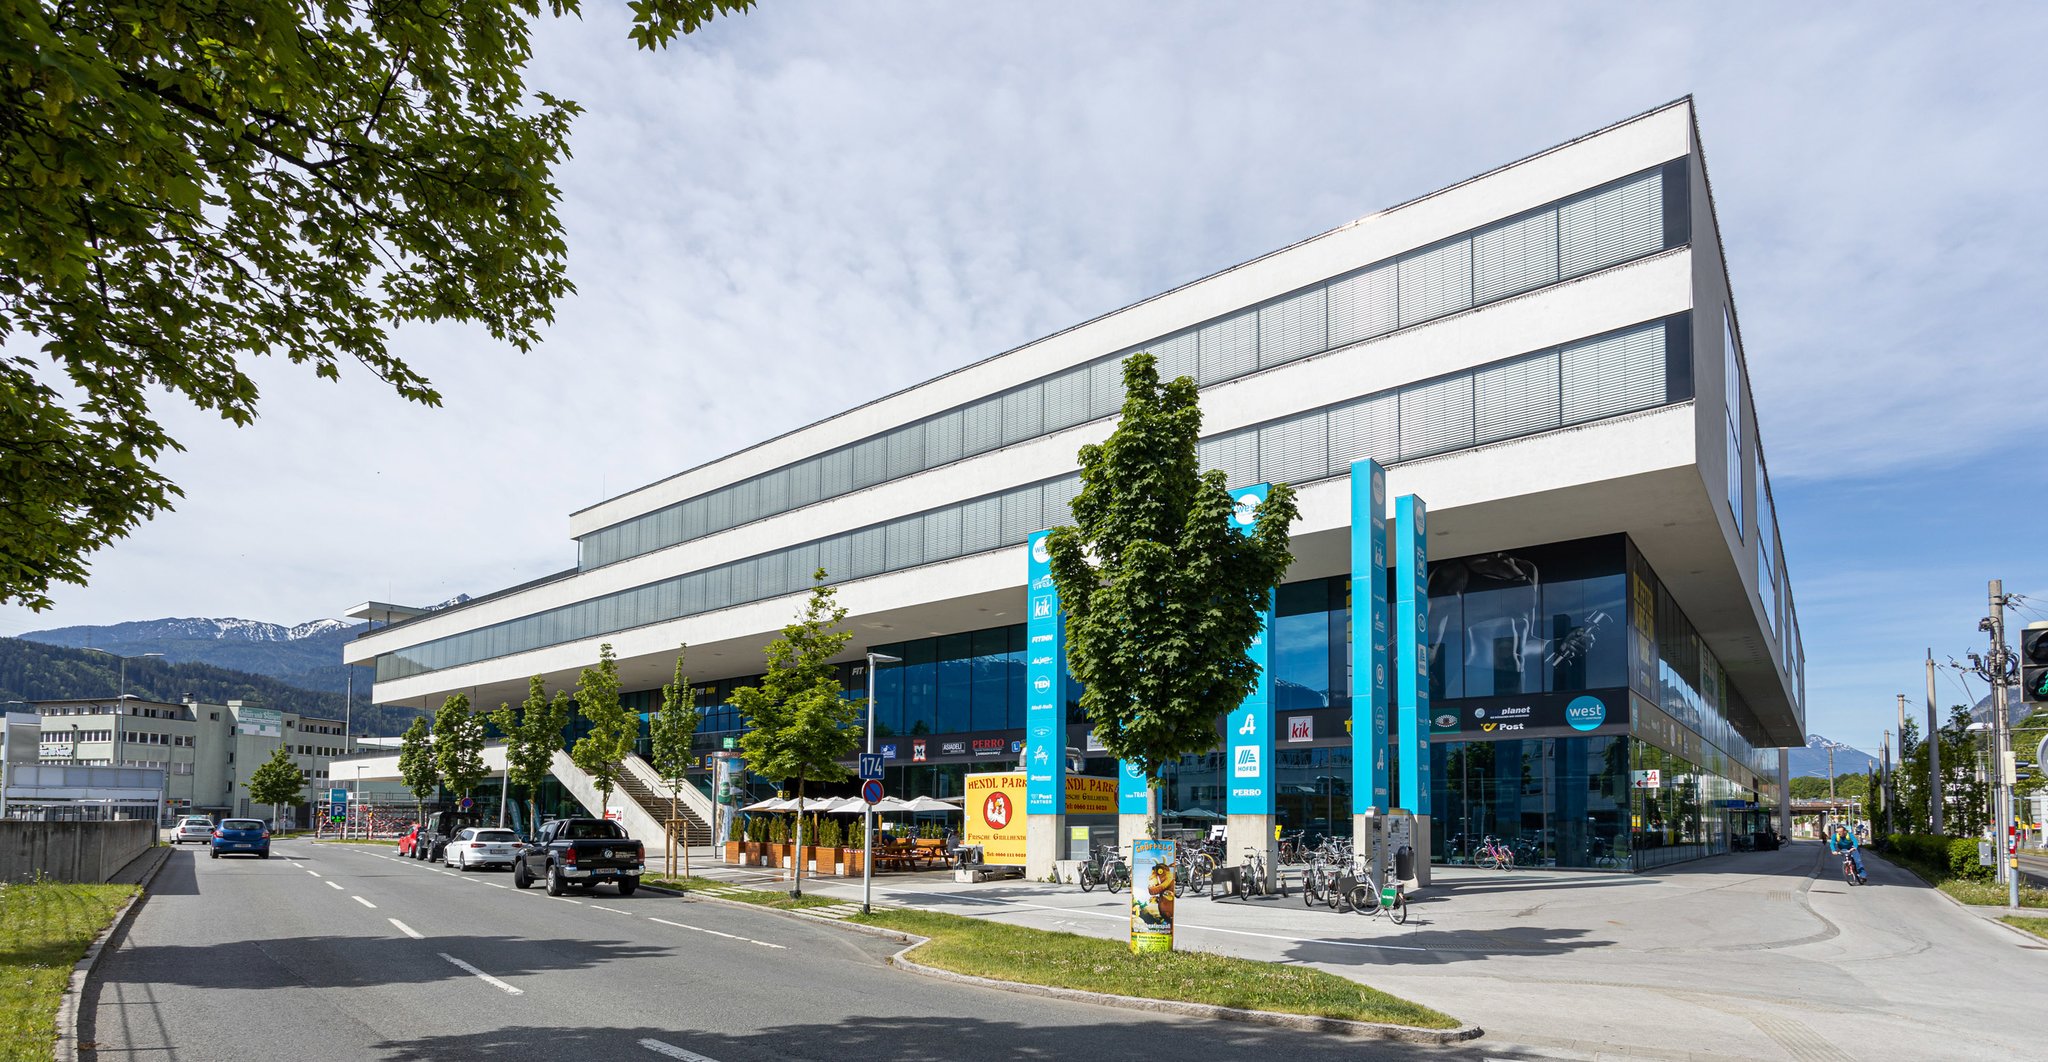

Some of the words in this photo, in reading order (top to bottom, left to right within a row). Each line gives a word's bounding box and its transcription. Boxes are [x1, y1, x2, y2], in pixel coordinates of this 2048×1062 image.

[1035, 597, 1050, 617] kik
[852, 667, 864, 676] FIT
[1501, 706, 1531, 716] planet
[1569, 704, 1602, 717] west
[1291, 719, 1310, 738] kik
[1499, 723, 1524, 731] Post
[972, 738, 1005, 749] PERRO
[861, 756, 883, 777] 174
[968, 778, 998, 790] HENDL
[1001, 777, 1027, 789] PARK
[1066, 778, 1086, 791] NDL
[1088, 779, 1114, 792] PARK
[1232, 788, 1262, 797] PERRO
[334, 805, 344, 816] P
